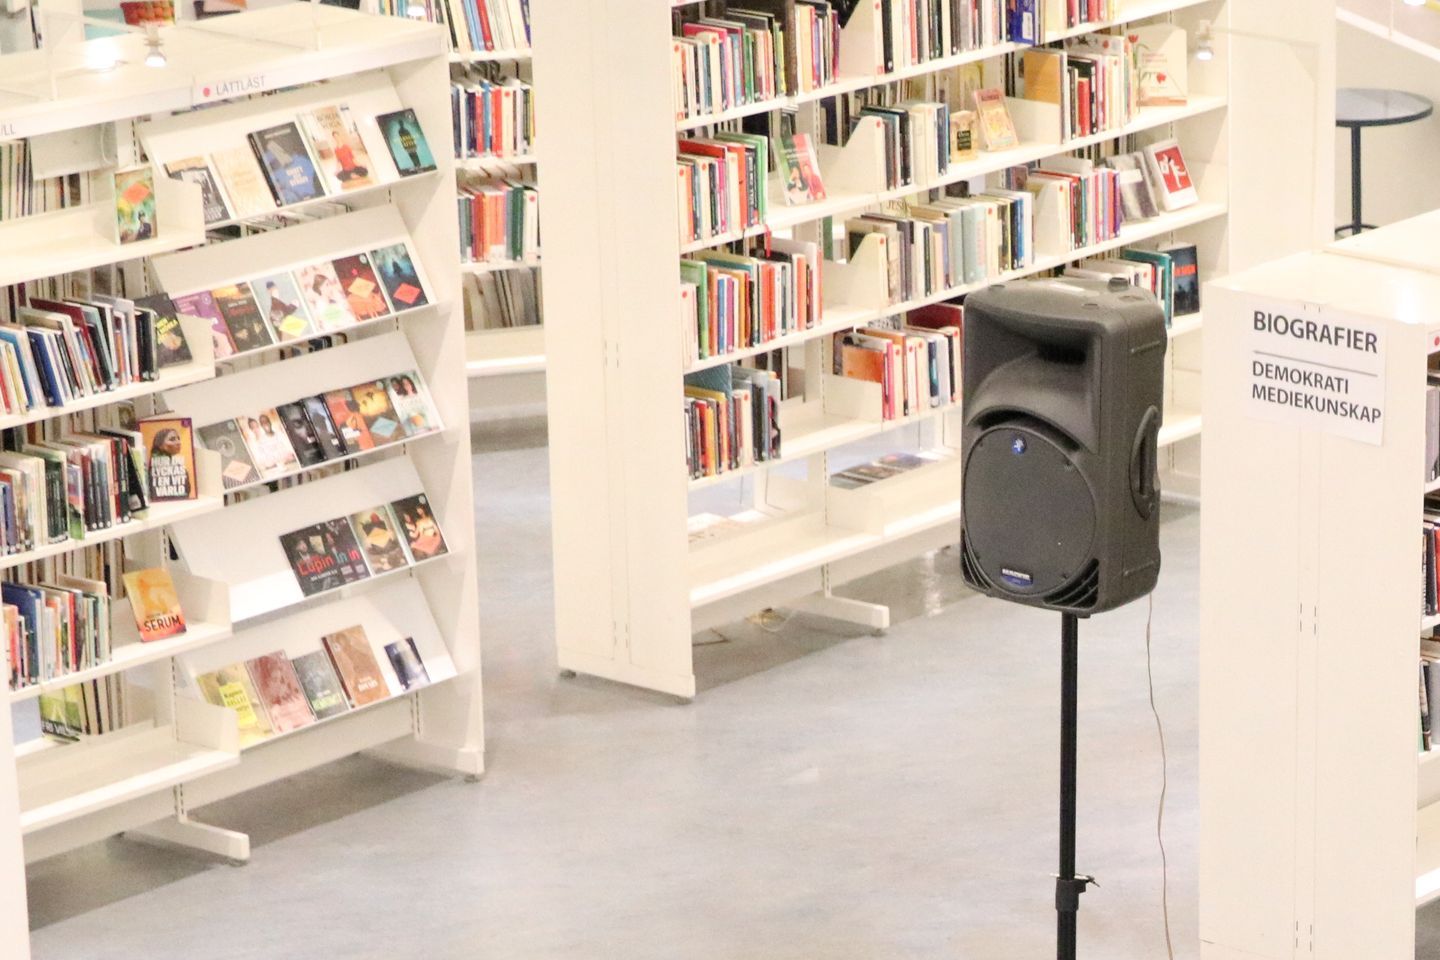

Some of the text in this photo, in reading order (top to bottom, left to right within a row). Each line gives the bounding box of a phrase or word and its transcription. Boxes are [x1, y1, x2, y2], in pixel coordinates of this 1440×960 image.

[1253, 310, 1378, 354] BIOGRAFIER
[1252, 360, 1349, 394] DEMOKRATI
[1252, 383, 1381, 423] MEDIEKUNSKAP
[151, 465, 187, 478] LYCKAS
[157, 476, 170, 486] EN
[171, 474, 187, 486] VIT
[143, 614, 182, 632] SERUM
